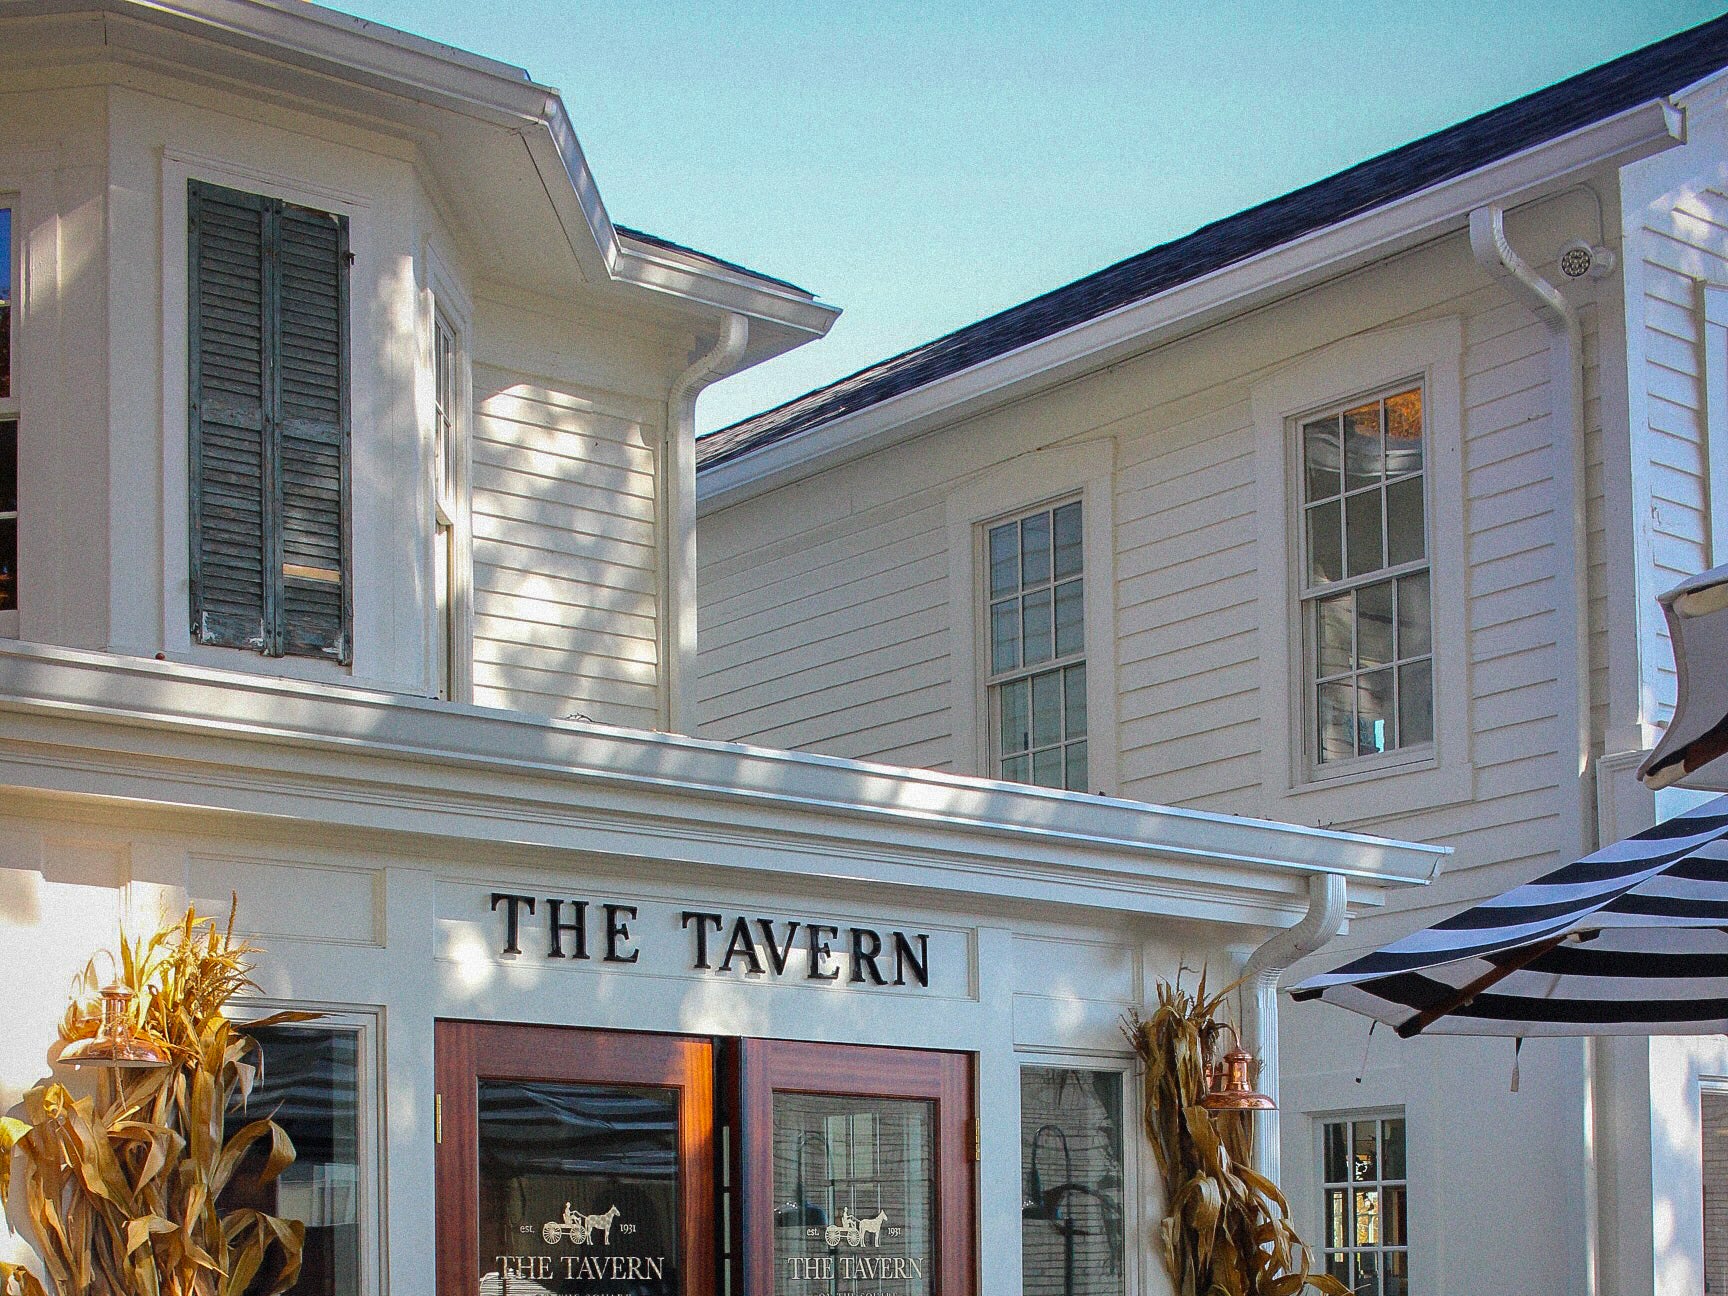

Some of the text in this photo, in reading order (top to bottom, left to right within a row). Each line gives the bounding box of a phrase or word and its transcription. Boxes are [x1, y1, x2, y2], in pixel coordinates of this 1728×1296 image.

[491, 893, 930, 987] THE TAVERN
[520, 1224, 636, 1234] est. 1931
[806, 1227, 901, 1236] est. 1931
[495, 1256, 665, 1280] THE TAVERN
[788, 1257, 924, 1280] THE TAVERN
